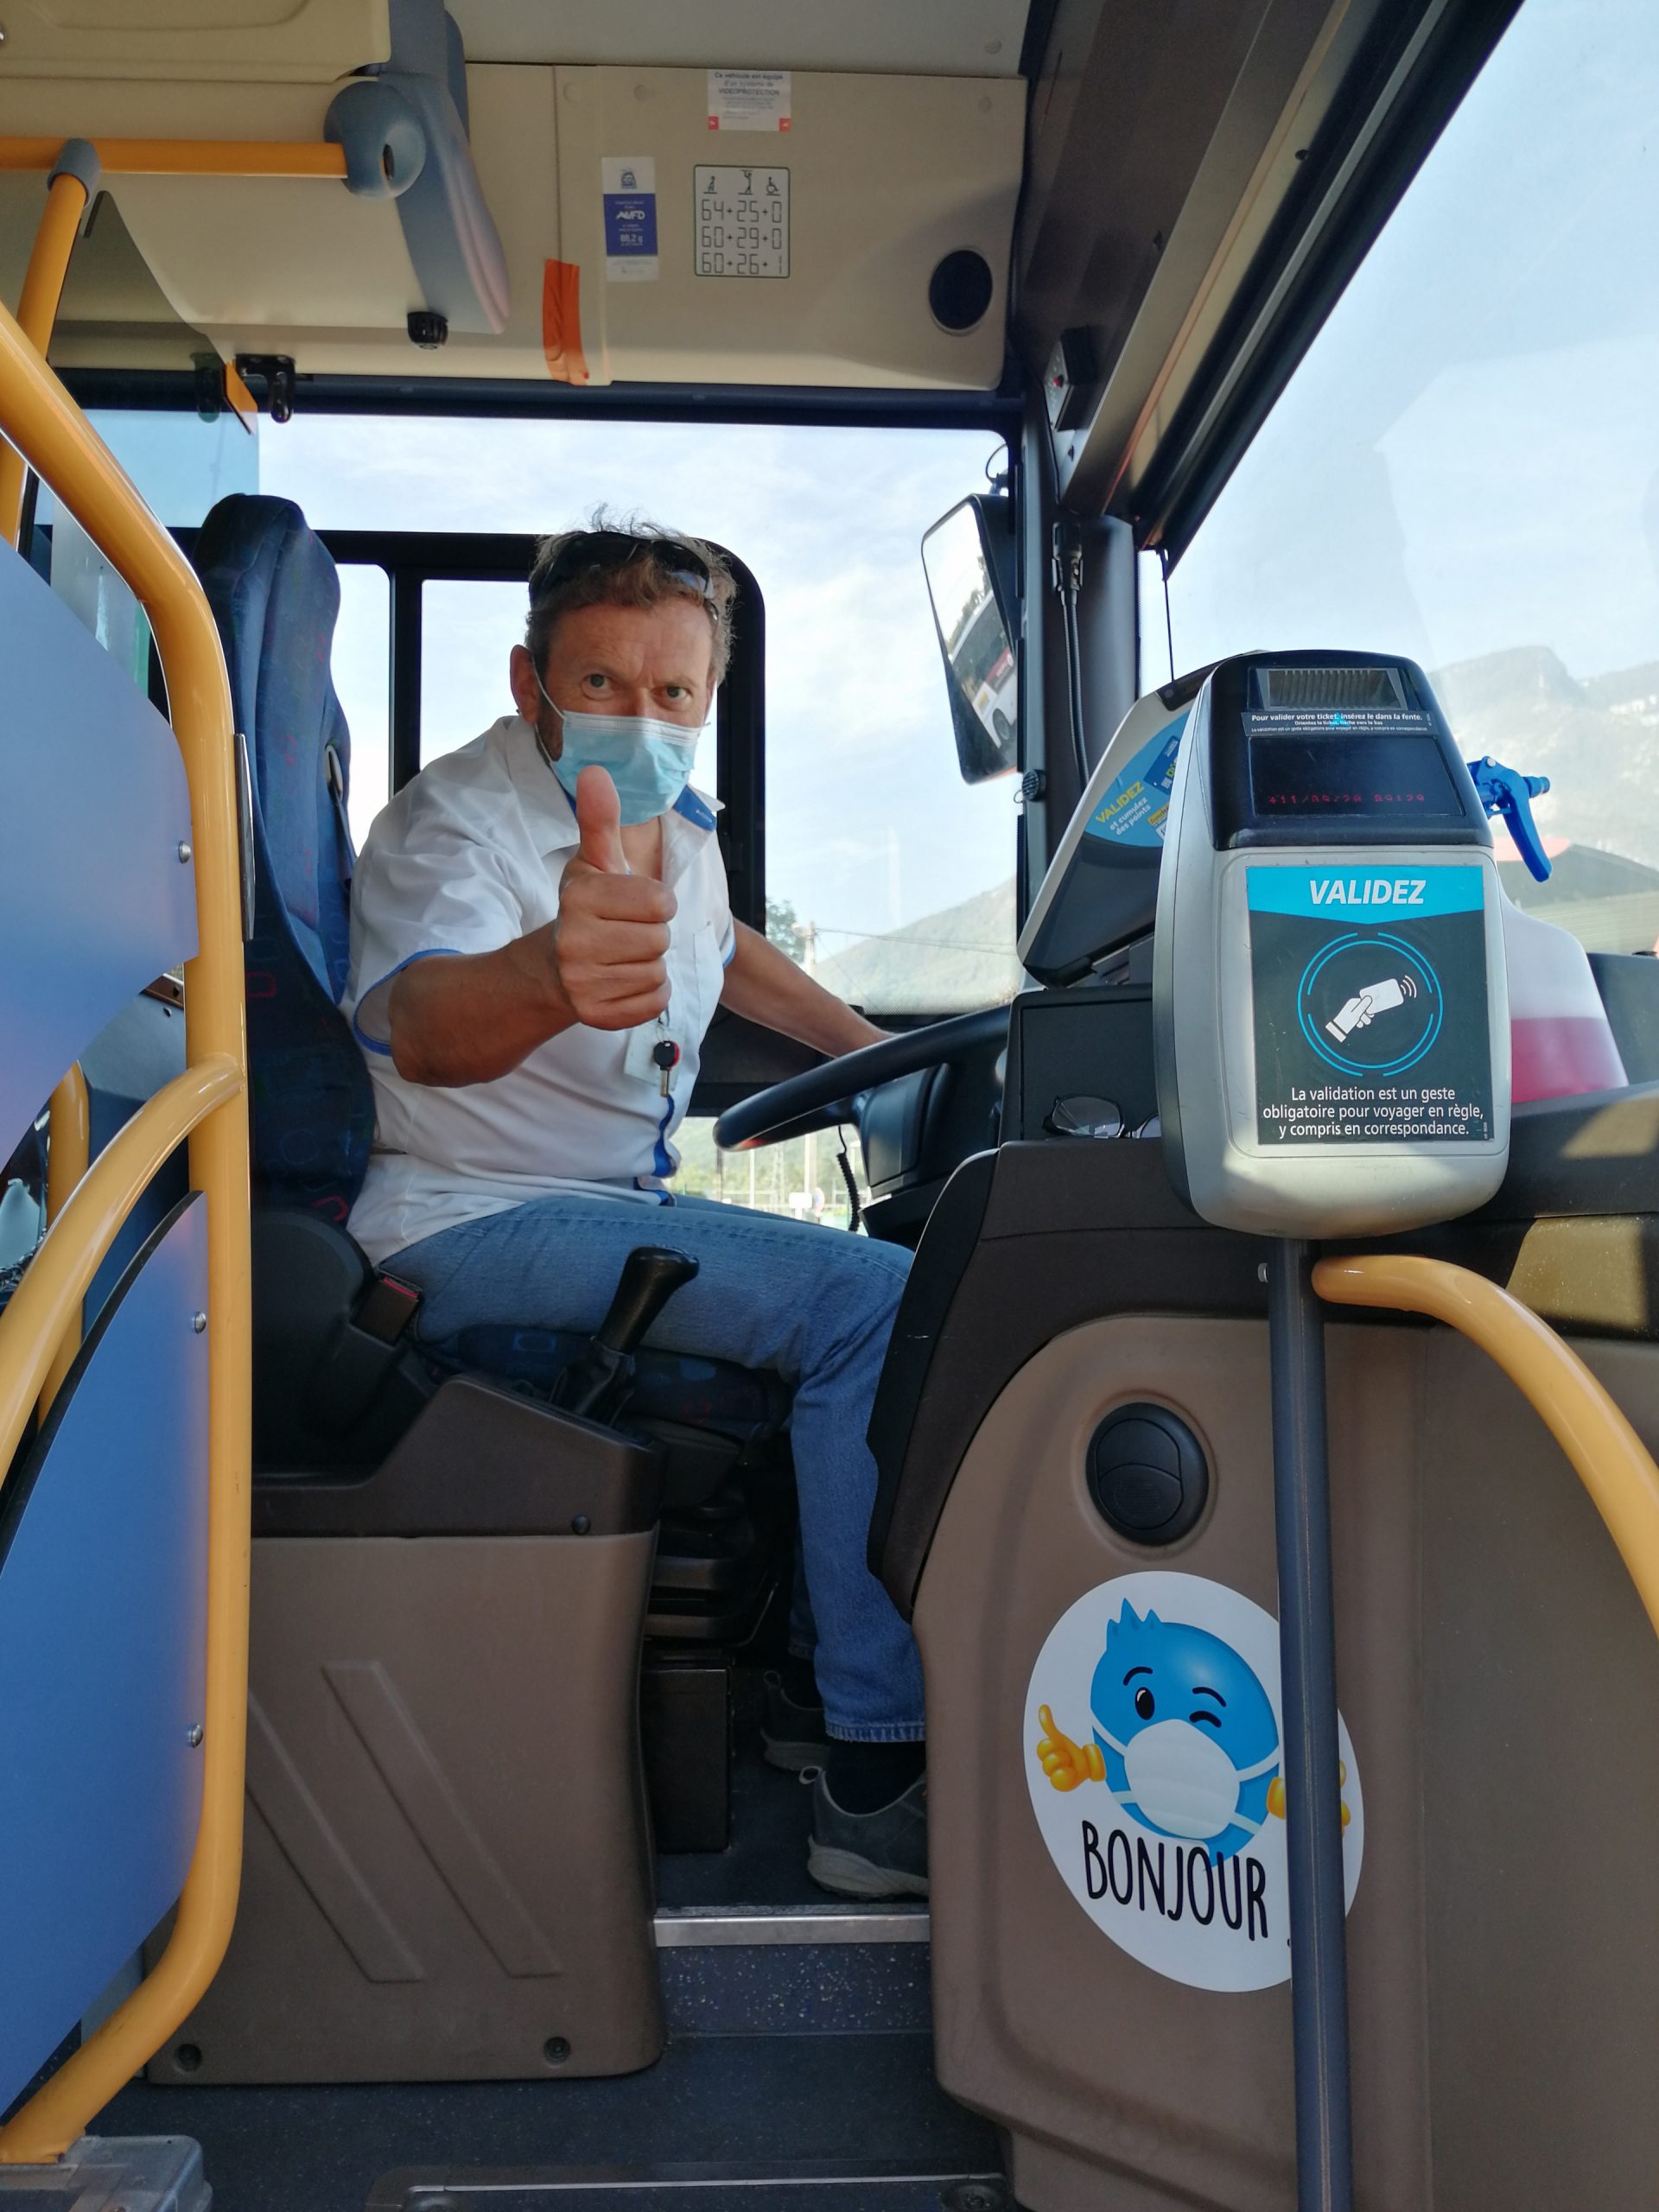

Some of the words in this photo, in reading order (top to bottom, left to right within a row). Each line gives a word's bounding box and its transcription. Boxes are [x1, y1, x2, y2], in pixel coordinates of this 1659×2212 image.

[702, 199, 724, 221] 64
[737, 200, 760, 222] 25
[702, 226, 724, 248] 60
[737, 226, 760, 249] 29
[702, 252, 724, 274] 60
[737, 253, 760, 275] 26
[1096, 781, 1145, 823] VALIDEZ
[1109, 821, 1119, 830] et
[1118, 797, 1148, 822] cumulez
[1116, 823, 1129, 836] des
[1128, 804, 1151, 827] points
[1309, 879, 1427, 906] VALIDEZ
[1292, 1087, 1306, 1101] La
[1309, 1086, 1375, 1101] validation
[1379, 1087, 1397, 1100] est
[1401, 1089, 1417, 1100] un
[1421, 1087, 1456, 1103] geste
[1262, 1103, 1335, 1122] obligatoire
[1338, 1107, 1370, 1122] pour
[1373, 1106, 1425, 1121] voyager
[1428, 1107, 1444, 1117] en
[1448, 1103, 1484, 1121] règle,
[1279, 1125, 1287, 1140] y
[1289, 1122, 1341, 1139] compris
[1344, 1125, 1361, 1135] en
[1364, 1120, 1469, 1138] correspondance.
[1082, 1820, 1268, 1942] BONJOUR
